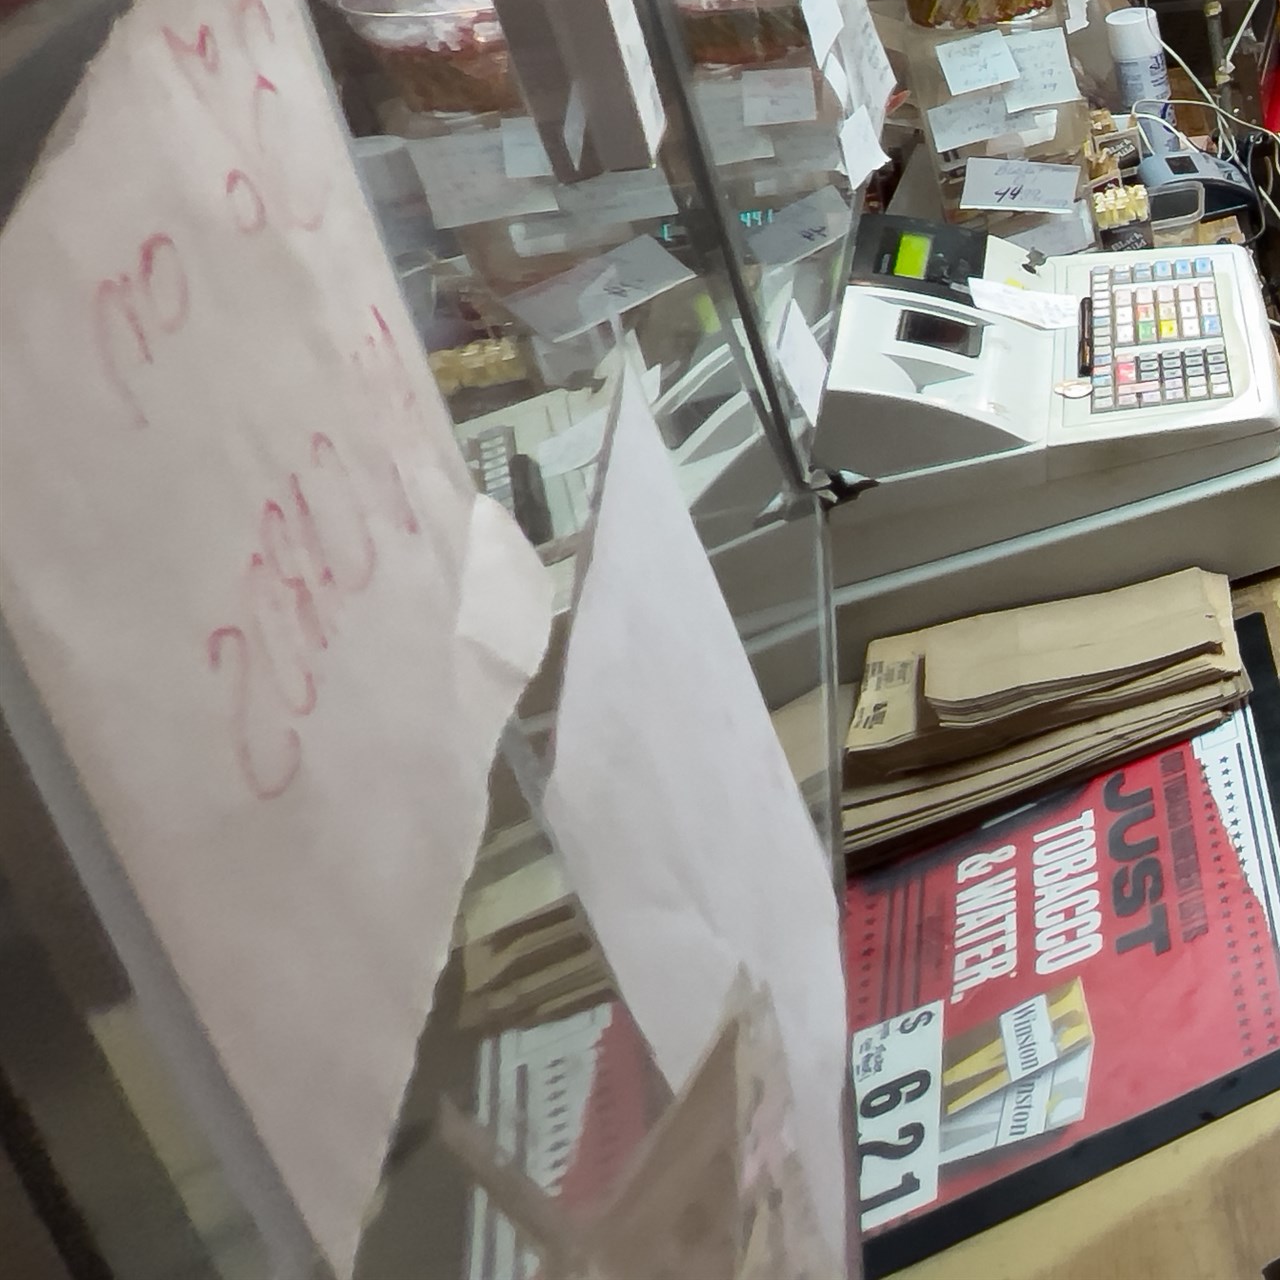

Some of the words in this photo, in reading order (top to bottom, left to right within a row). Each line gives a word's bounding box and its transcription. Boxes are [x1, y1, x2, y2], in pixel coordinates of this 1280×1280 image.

[956, 844, 1018, 882] &
[1033, 808, 1104, 976] TOBACCO
[1102, 771, 1172, 957] JUST
[899, 1010, 936, 1035] $
[1012, 1002, 1041, 1071] Winston
